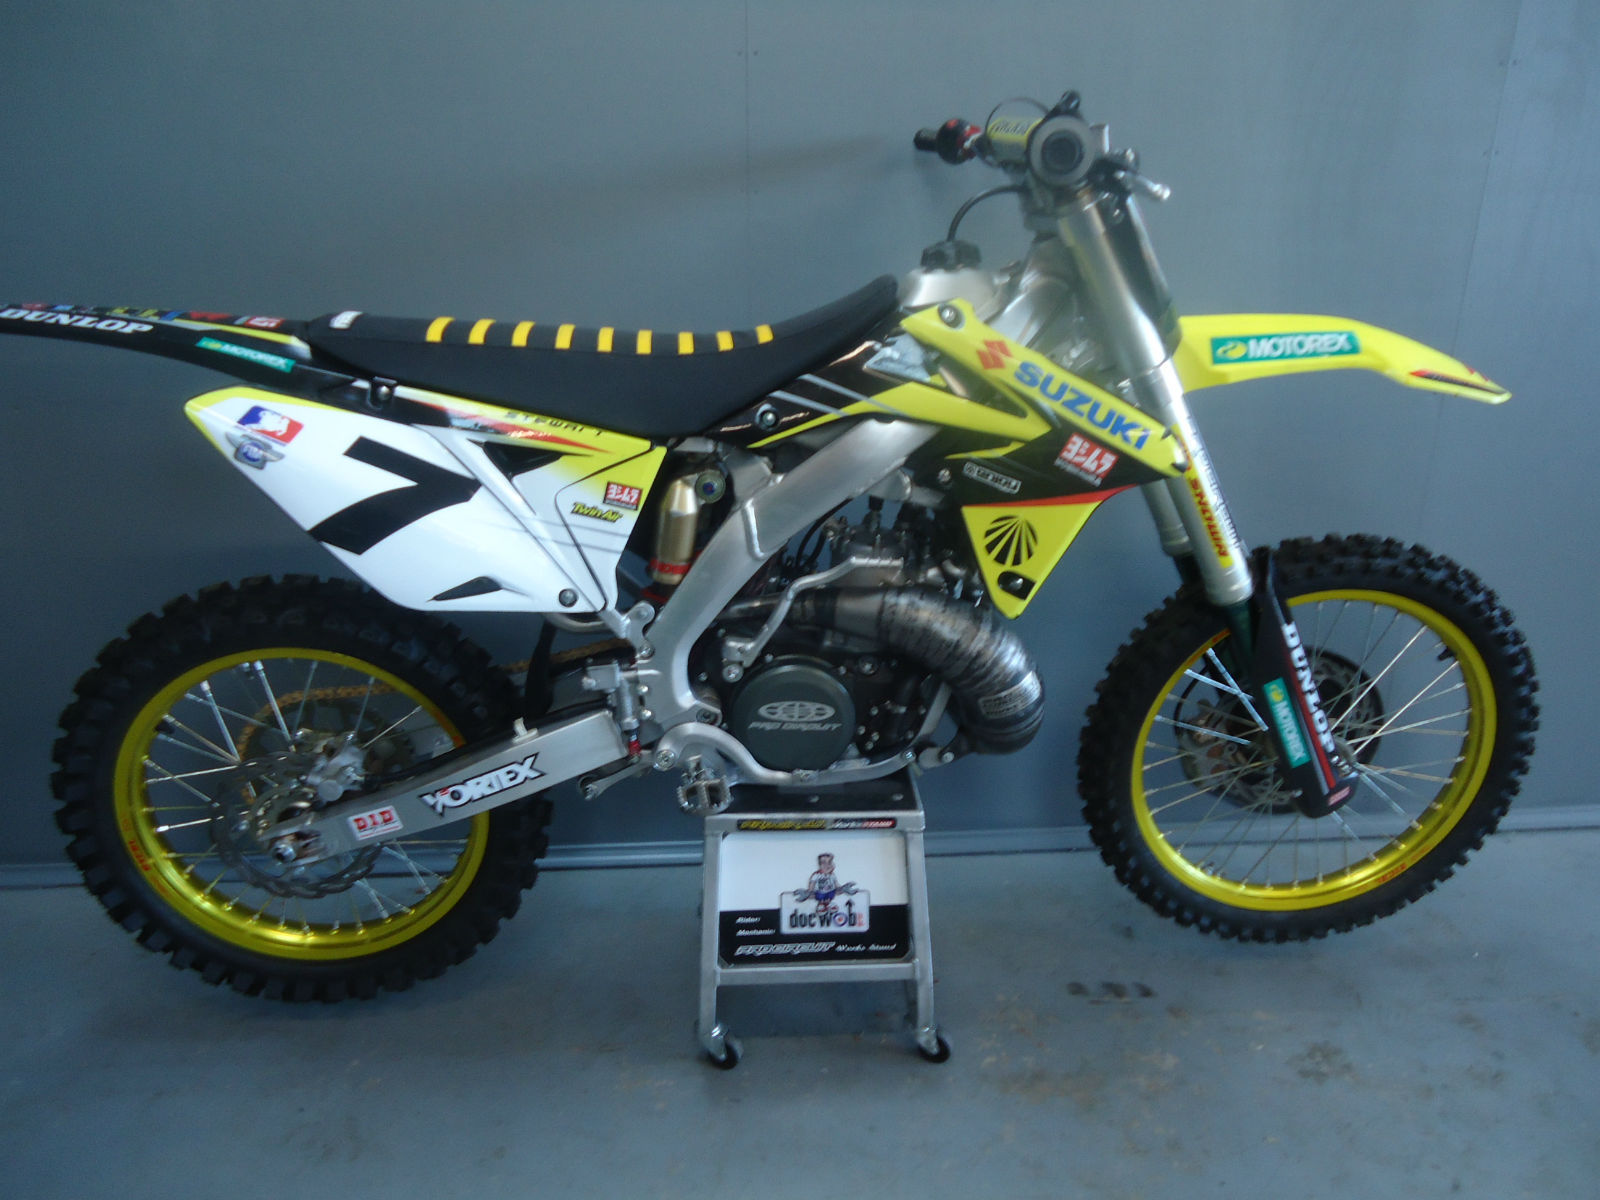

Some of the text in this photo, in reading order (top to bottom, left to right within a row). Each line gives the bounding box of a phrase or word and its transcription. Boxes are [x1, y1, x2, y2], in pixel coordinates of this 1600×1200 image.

[0, 308, 154, 333] DUNLOP
[1247, 332, 1352, 359] MOTOREX
[1014, 361, 1150, 450] SUZUKI
[306, 435, 483, 556] 7
[1281, 620, 1335, 753] DUNLOP
[1271, 701, 1307, 762] MOTOREX
[418, 752, 546, 816] VORTEX
